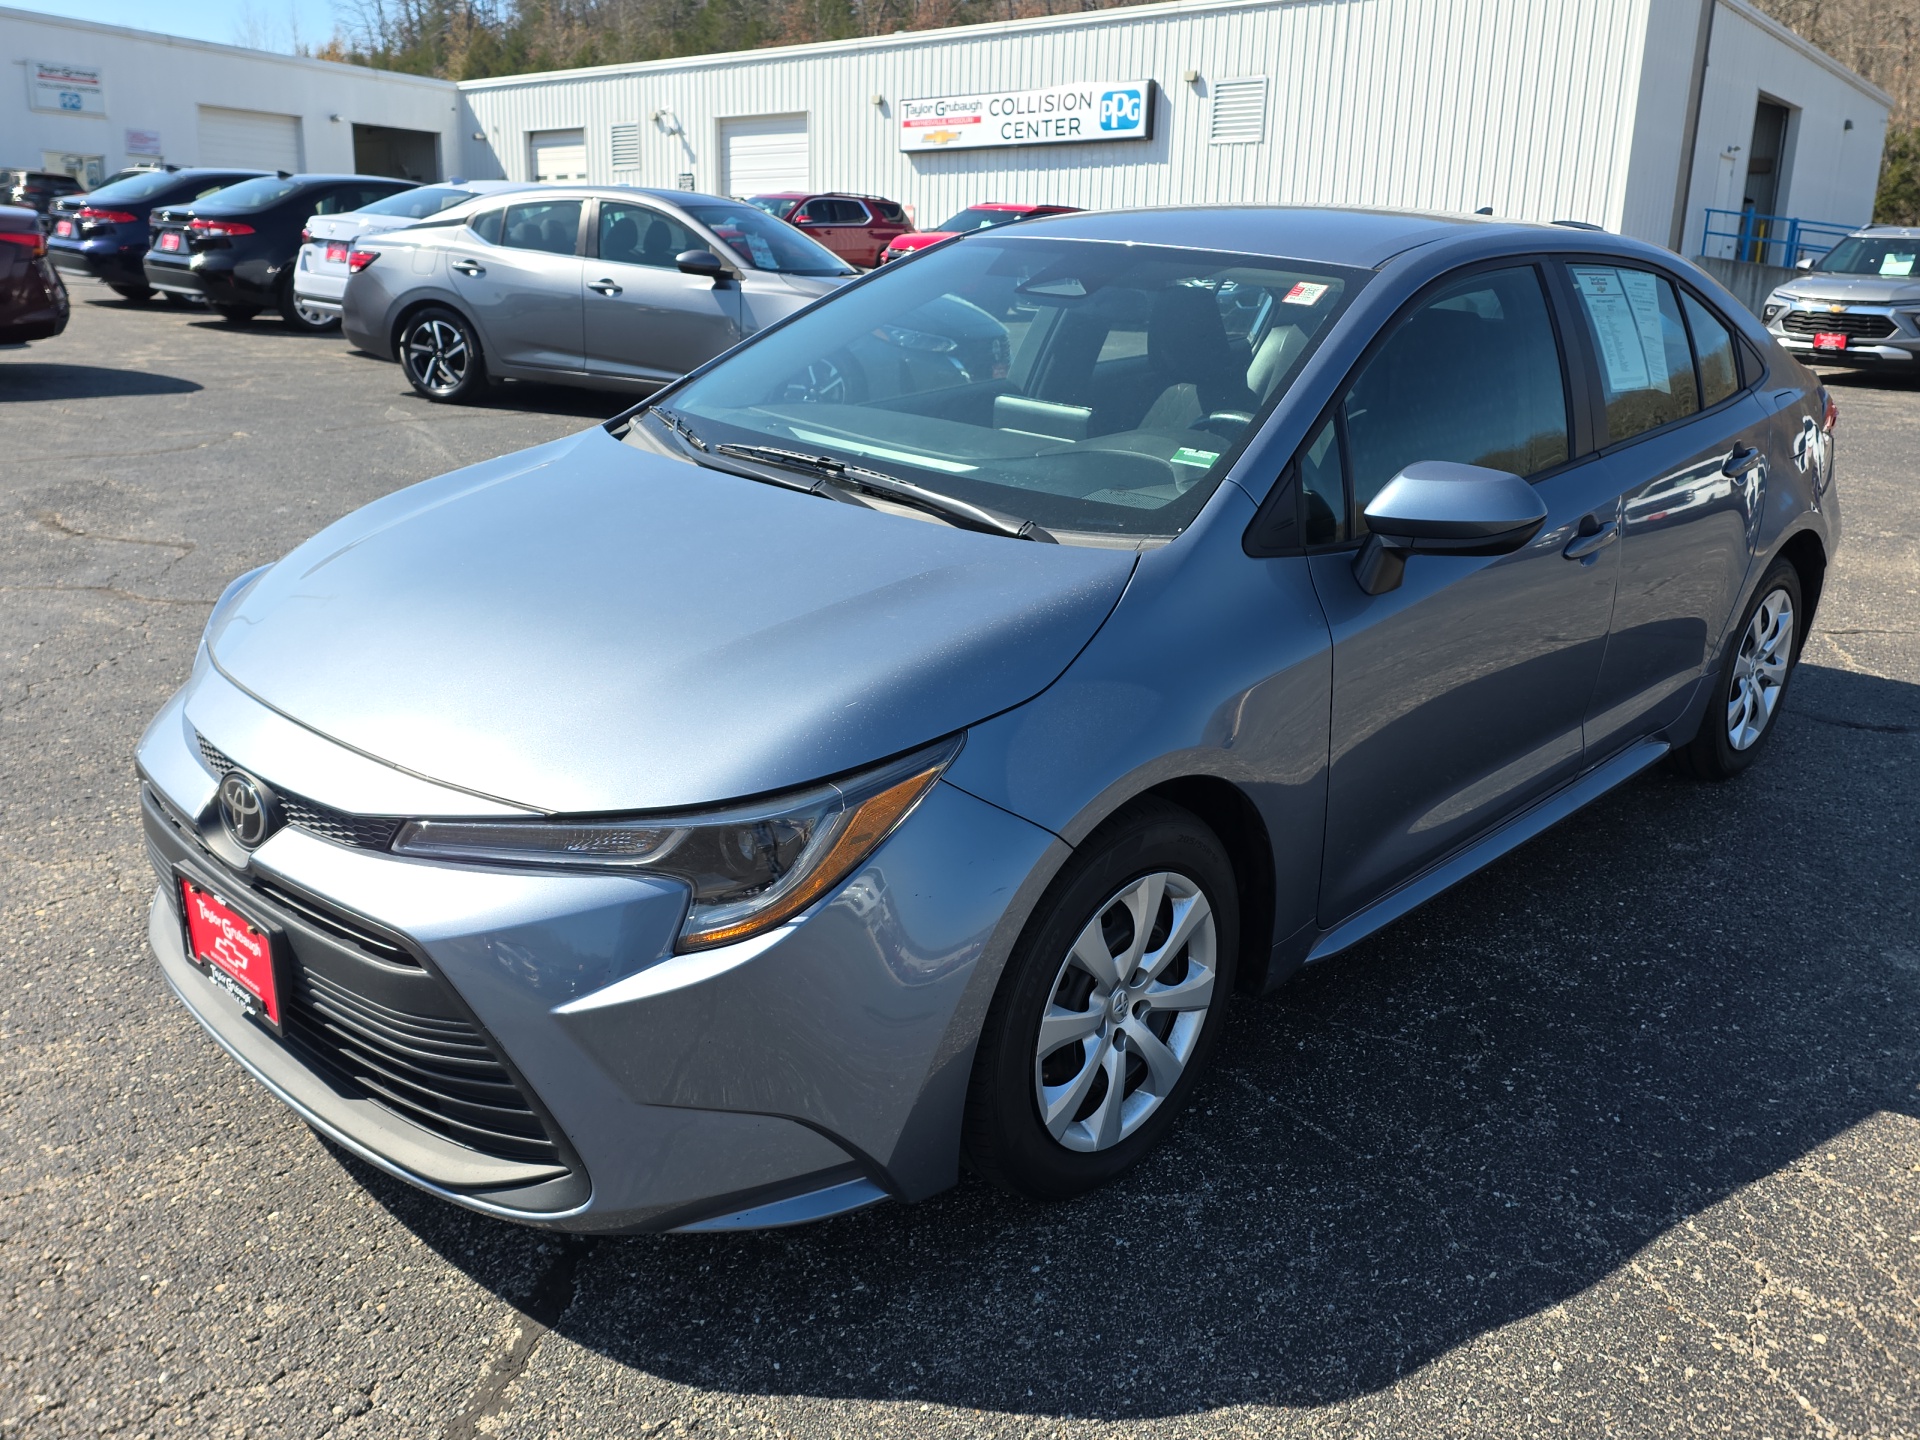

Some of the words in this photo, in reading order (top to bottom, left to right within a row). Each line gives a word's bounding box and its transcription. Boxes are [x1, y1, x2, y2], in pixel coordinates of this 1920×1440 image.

[903, 103, 932, 118] Taylor
[936, 100, 982, 116] Grubaugh
[989, 92, 1093, 116] COLLISION
[1100, 93, 1140, 128] PPG
[1001, 117, 1081, 139] CENTER
[196, 898, 222, 928] Taylor
[222, 918, 262, 957] Grubaugh
